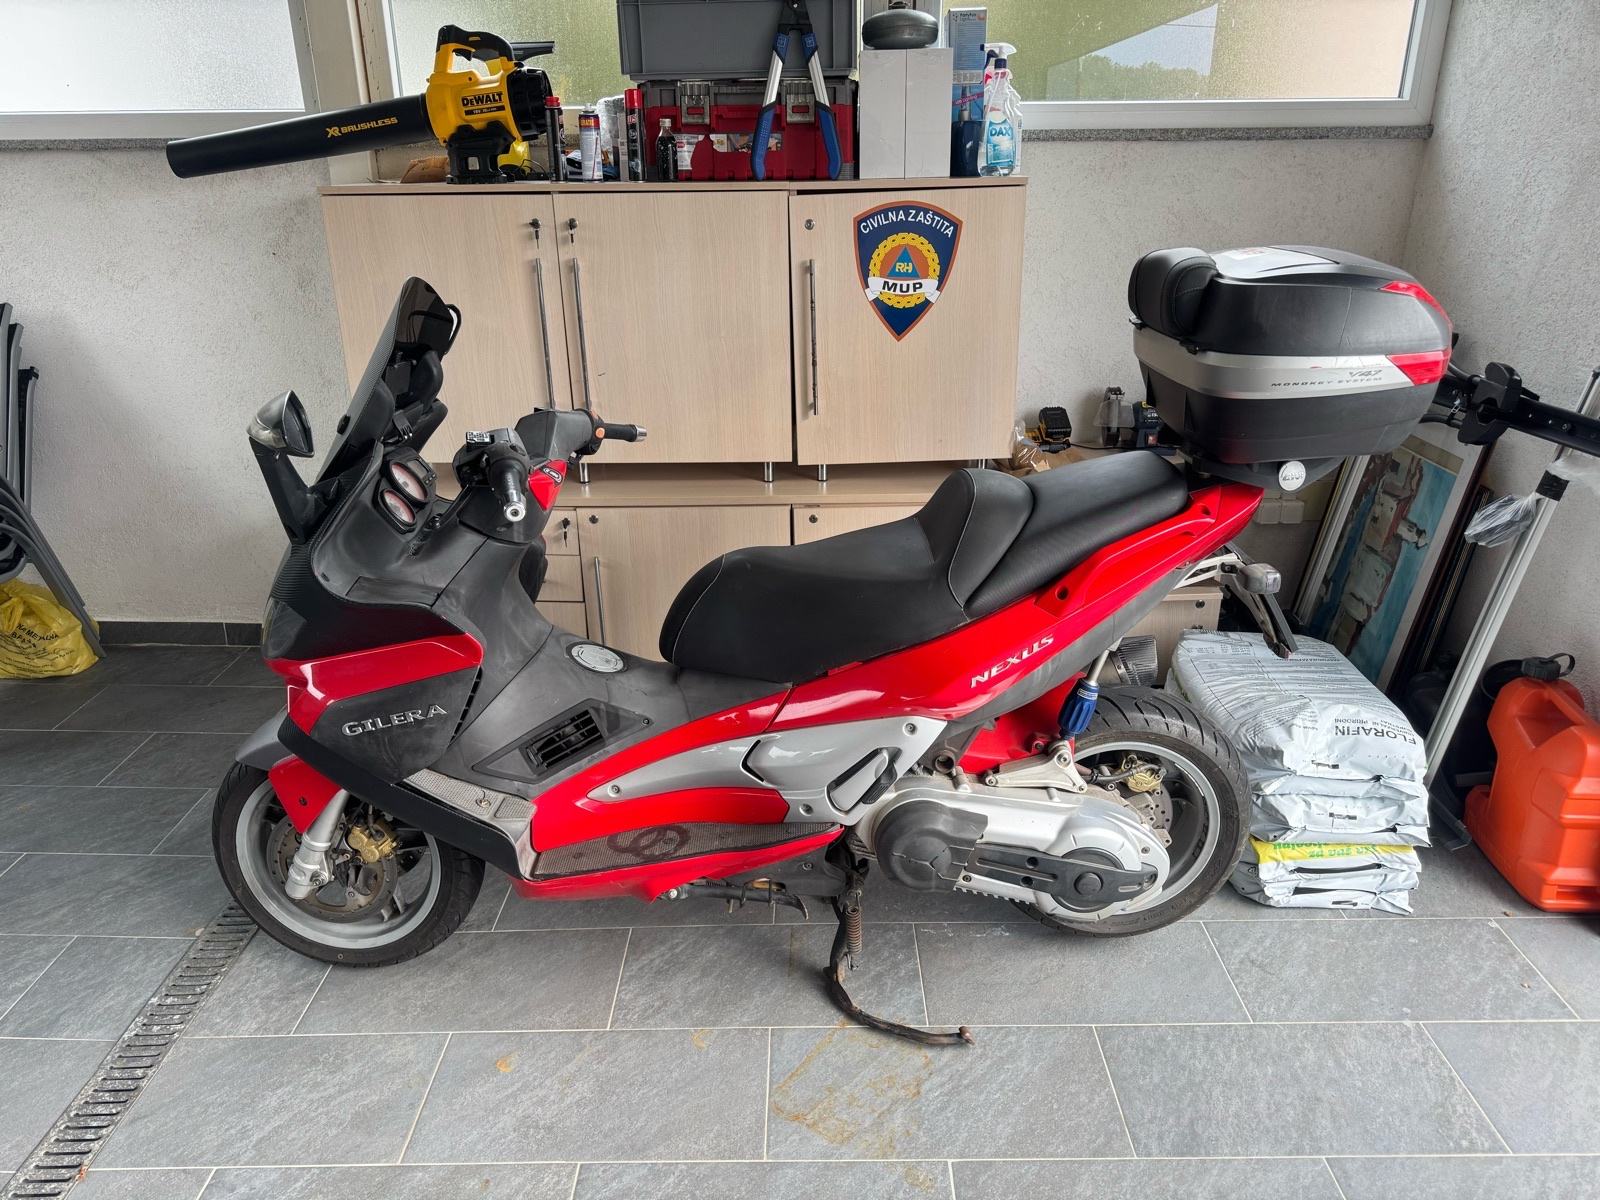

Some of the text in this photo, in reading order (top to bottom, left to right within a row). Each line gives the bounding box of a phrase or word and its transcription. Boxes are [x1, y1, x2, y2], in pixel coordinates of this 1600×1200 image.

[325, 116, 399, 138] XR BRUSHLESS
[989, 126, 1011, 137] DAX
[860, 209, 955, 238] CIVILNA ZAŠTITA
[895, 262, 913, 273] RH
[881, 280, 924, 293] MUP
[971, 633, 1054, 688] NEXUS
[341, 704, 448, 736] GILERA
[1335, 725, 1417, 745] FLORAFIN
